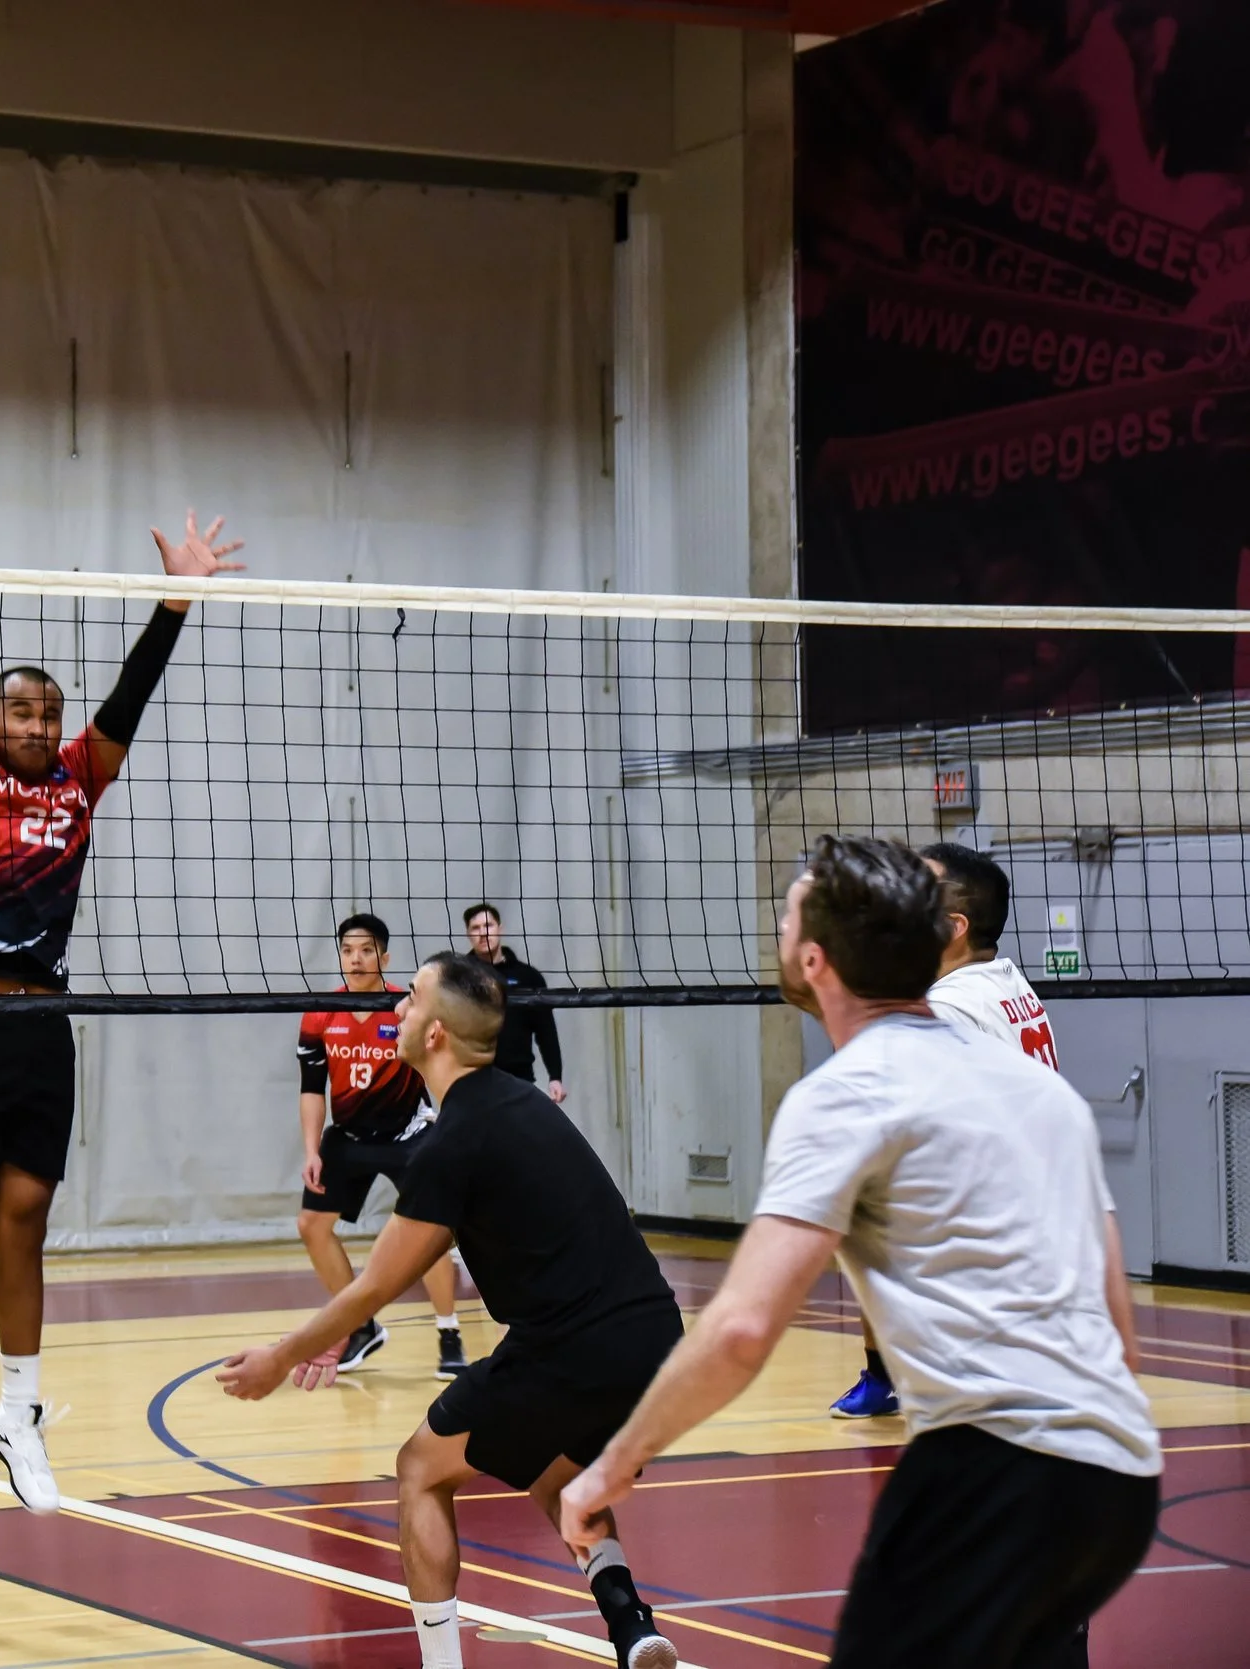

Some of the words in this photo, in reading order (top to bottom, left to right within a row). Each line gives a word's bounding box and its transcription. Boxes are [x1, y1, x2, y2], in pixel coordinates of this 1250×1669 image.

[943, 148, 1003, 206] GO
[918, 227, 977, 271] GO
[865, 296, 1168, 388] www.geegees
[934, 768, 965, 804] EXIT
[20, 805, 71, 850] 22
[1047, 952, 1078, 972] EXIT
[325, 1042, 396, 1060] Montrea
[350, 1062, 372, 1090] 13
